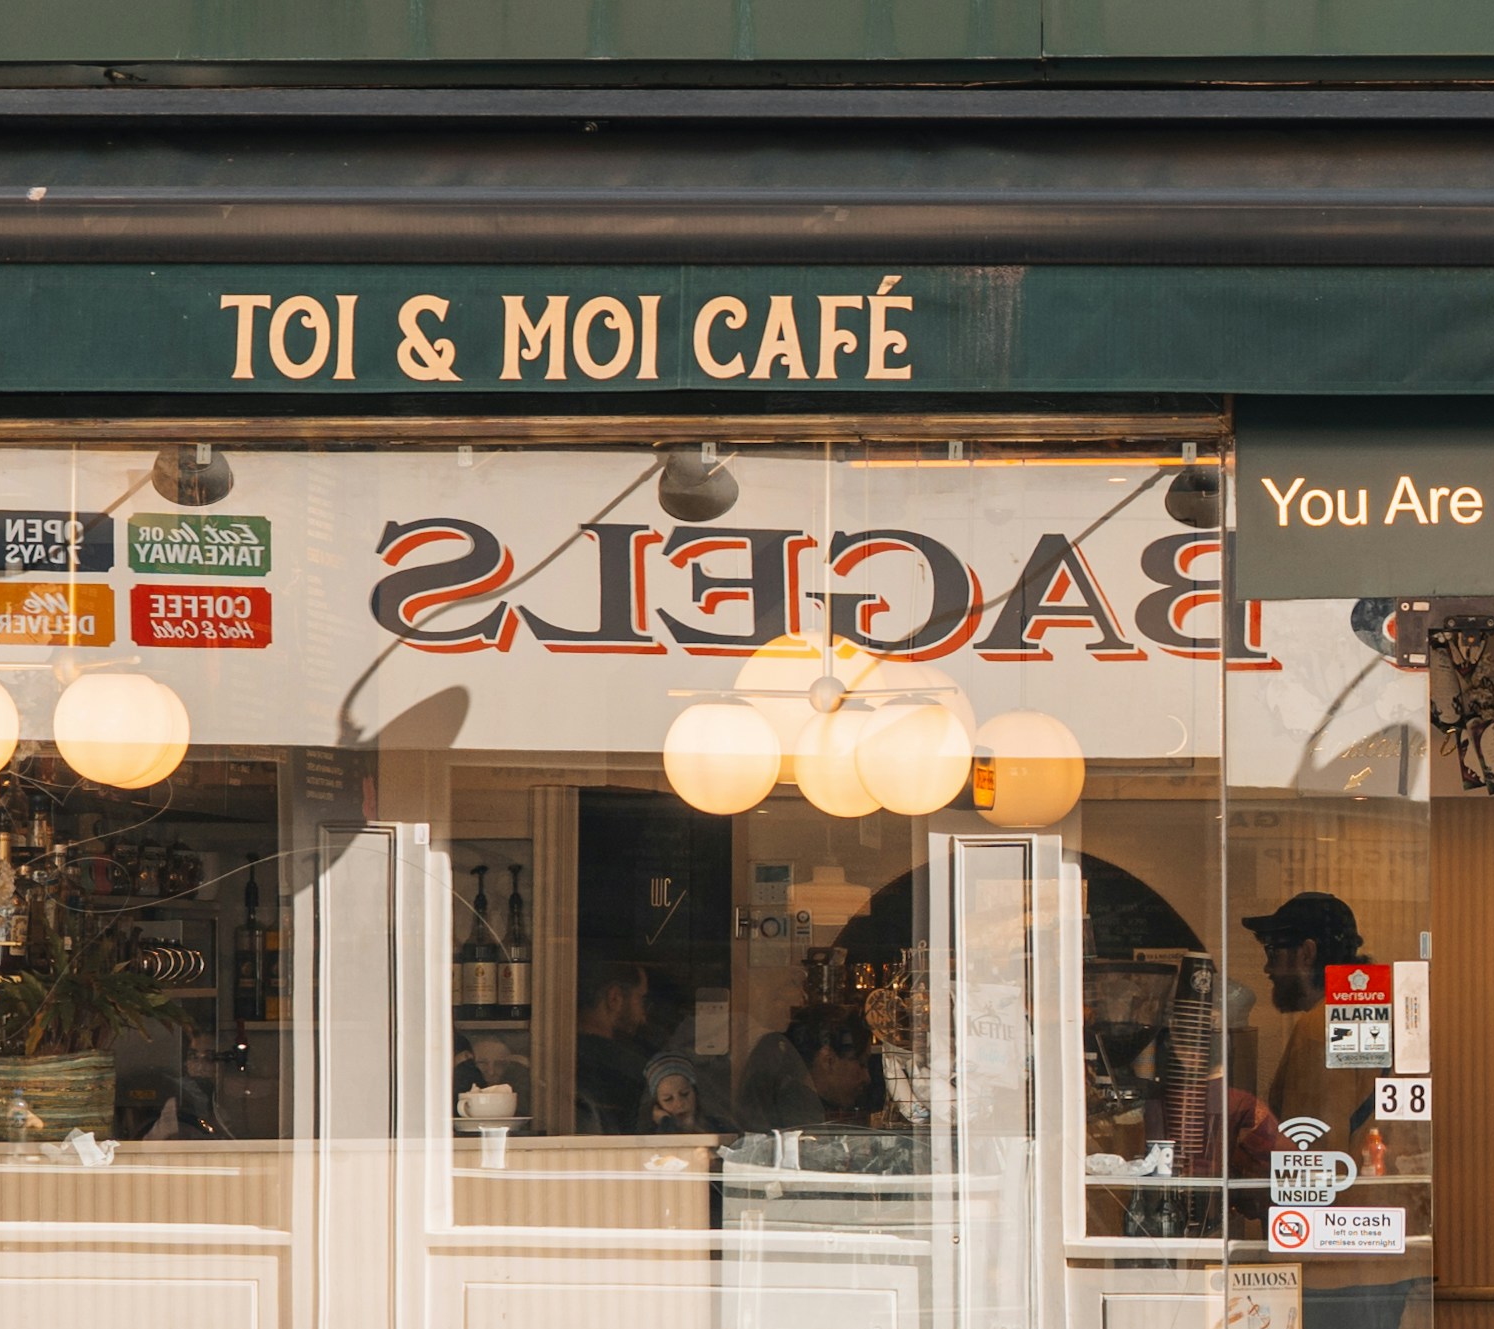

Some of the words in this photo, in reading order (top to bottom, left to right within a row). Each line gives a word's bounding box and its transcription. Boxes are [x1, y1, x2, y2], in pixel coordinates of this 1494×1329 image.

[219, 293, 359, 381] TOI
[396, 293, 464, 382] &
[498, 294, 664, 381] MOI
[692, 274, 914, 381] CAFÉ
[1261, 476, 1368, 527] You
[1384, 475, 1484, 526] Are
[1332, 991, 1386, 1001] verisure
[1330, 1007, 1390, 1022] ALARM
[1283, 1154, 1324, 1167] FREE
[1277, 1190, 1329, 1203] INSIDE
[1324, 1213, 1347, 1227] No
[1352, 1213, 1392, 1227] cash
[1319, 1239, 1356, 1248] premises
[1358, 1239, 1396, 1248] overnight
[1232, 1271, 1299, 1287] MIMOSA
